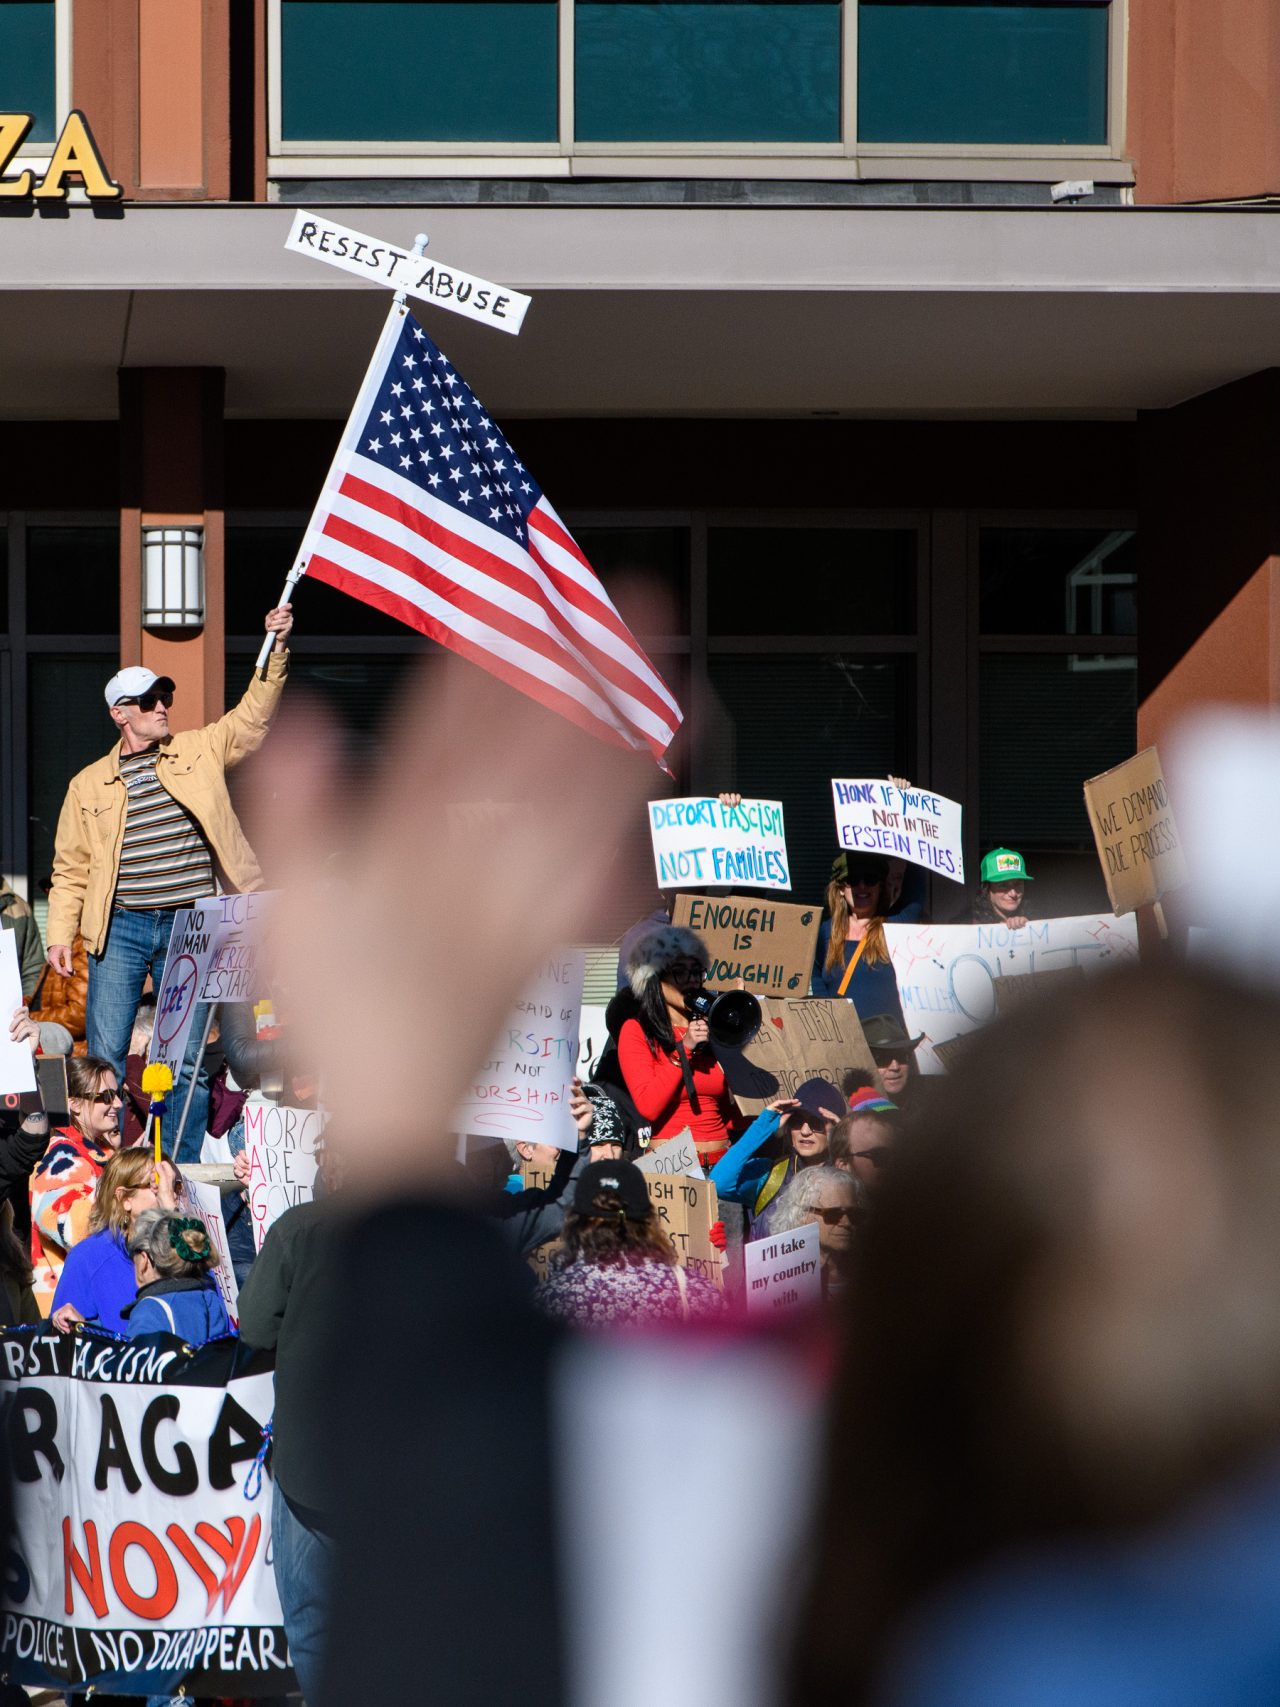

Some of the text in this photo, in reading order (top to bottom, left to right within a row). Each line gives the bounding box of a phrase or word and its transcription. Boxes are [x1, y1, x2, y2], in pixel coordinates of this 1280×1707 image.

[298, 221, 510, 318] RESIST ABUSE
[835, 782, 876, 805] HONK
[880, 785, 894, 806] IF
[1096, 779, 1169, 836] WE DEMAND
[652, 799, 716, 830] DEPORT
[872, 809, 940, 839] NOT IN THE
[842, 824, 955, 874] EPSTEIN FILES
[1105, 817, 1178, 876] DUE PROCESS
[659, 847, 706, 881] NOT
[185, 911, 205, 932] NO
[219, 893, 260, 925] ICE
[689, 900, 775, 932] ENOUGH
[171, 934, 211, 956] HUMAN
[733, 933, 752, 950] IS
[977, 922, 1049, 949] NOEM
[787, 1000, 844, 1043] THY
[515, 1063, 547, 1078] NOT
[249, 1145, 296, 1184] ARE
[649, 1182, 697, 1208] ISH TO
[781, 1238, 806, 1255] take
[752, 1260, 817, 1291] my country
[4, 1335, 61, 1379] RST
[62, 1512, 262, 1621] NOW
[1, 1614, 295, 1672] POLICE NO DISAPPEAR
